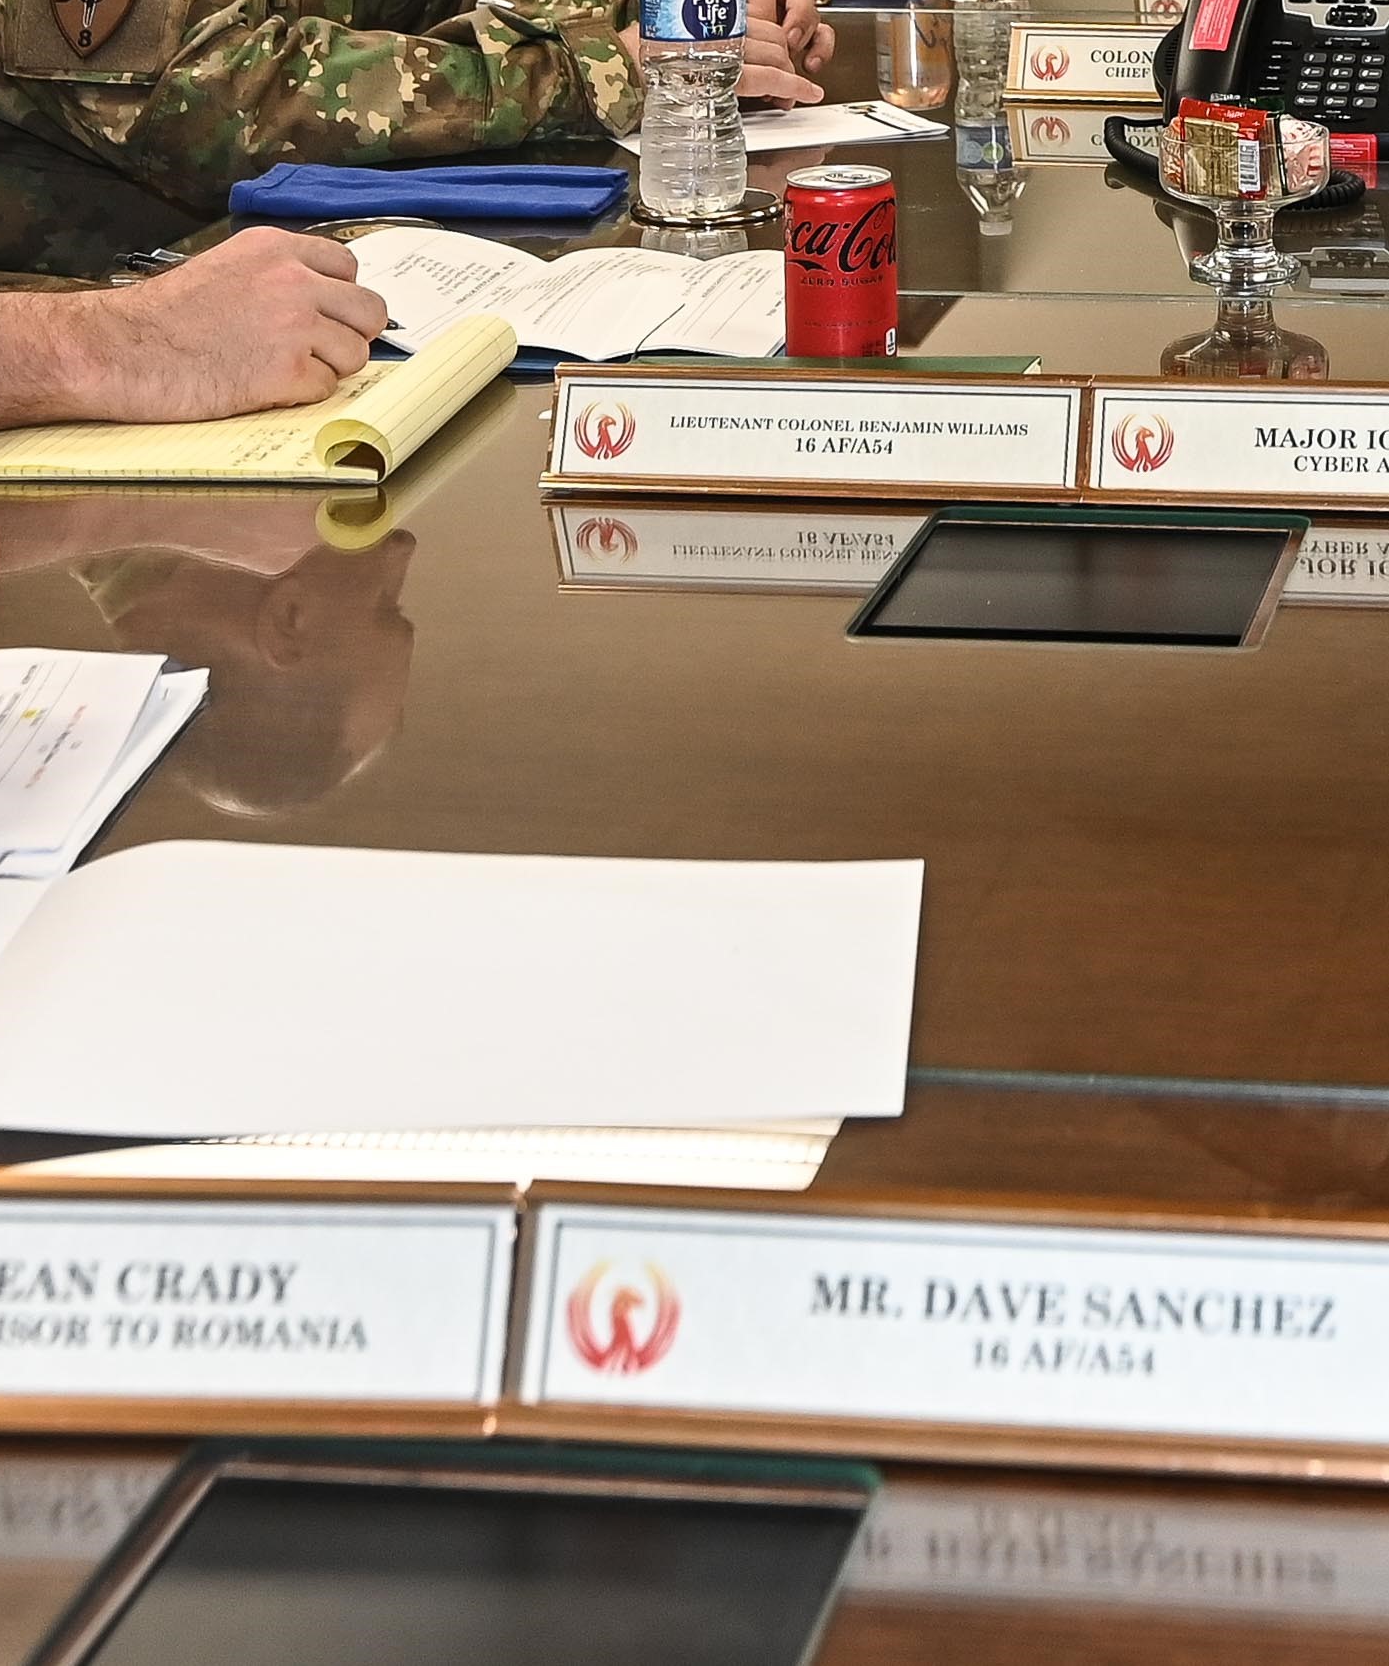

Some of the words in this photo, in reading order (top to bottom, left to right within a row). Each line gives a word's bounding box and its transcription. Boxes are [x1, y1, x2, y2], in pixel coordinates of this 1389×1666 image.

[698, 4, 727, 24] Life
[77, 29, 91, 48] 8
[1091, 50, 1154, 64] COLON
[1105, 67, 1151, 78] CHIEF
[800, 276, 835, 287] ZERO
[670, 416, 773, 430] LIEUTENANT
[778, 418, 855, 432] COLONEL
[859, 420, 943, 435] BENJAMIN
[948, 422, 1028, 436] WILLIAMS
[795, 437, 817, 453] 16
[824, 437, 893, 455] AF/A54
[1255, 427, 1356, 450] MAJOR
[1293, 456, 1369, 473] CYBER
[119, 1263, 300, 1306] CRADY
[810, 1276, 904, 1319] MR.
[924, 1282, 1066, 1326] DAVE
[1082, 1287, 1337, 1338] SANCHEZ
[105, 1314, 158, 1349] TO
[171, 1314, 370, 1351] ROMANIA
[971, 1338, 1009, 1370] 16
[1022, 1340, 1156, 1376] AF/A54
